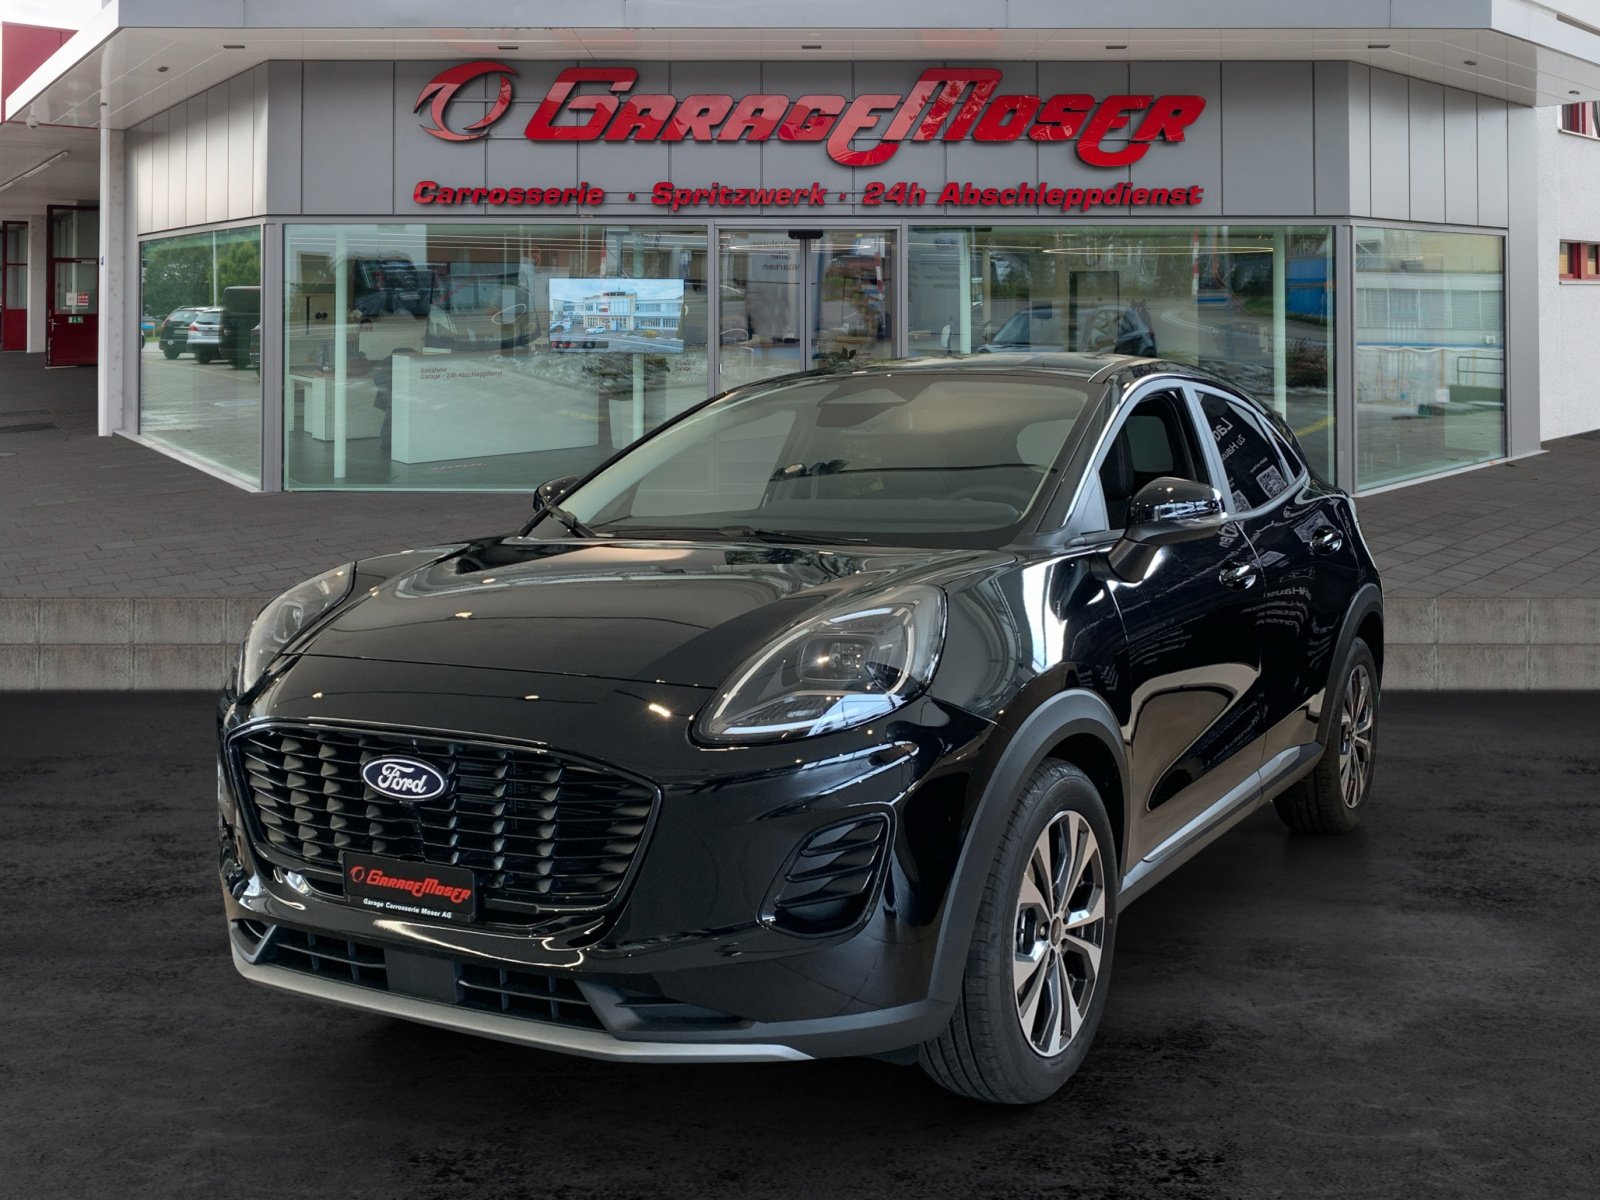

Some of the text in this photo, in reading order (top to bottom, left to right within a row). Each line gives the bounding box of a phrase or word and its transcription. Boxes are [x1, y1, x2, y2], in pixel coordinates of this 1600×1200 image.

[413, 181, 1204, 211] Carrosserie Spritzwerk 24h Abschleppdienst
[377, 763, 428, 794] Ford
[363, 898, 452, 919] Garage Carrosserie Moser AG
